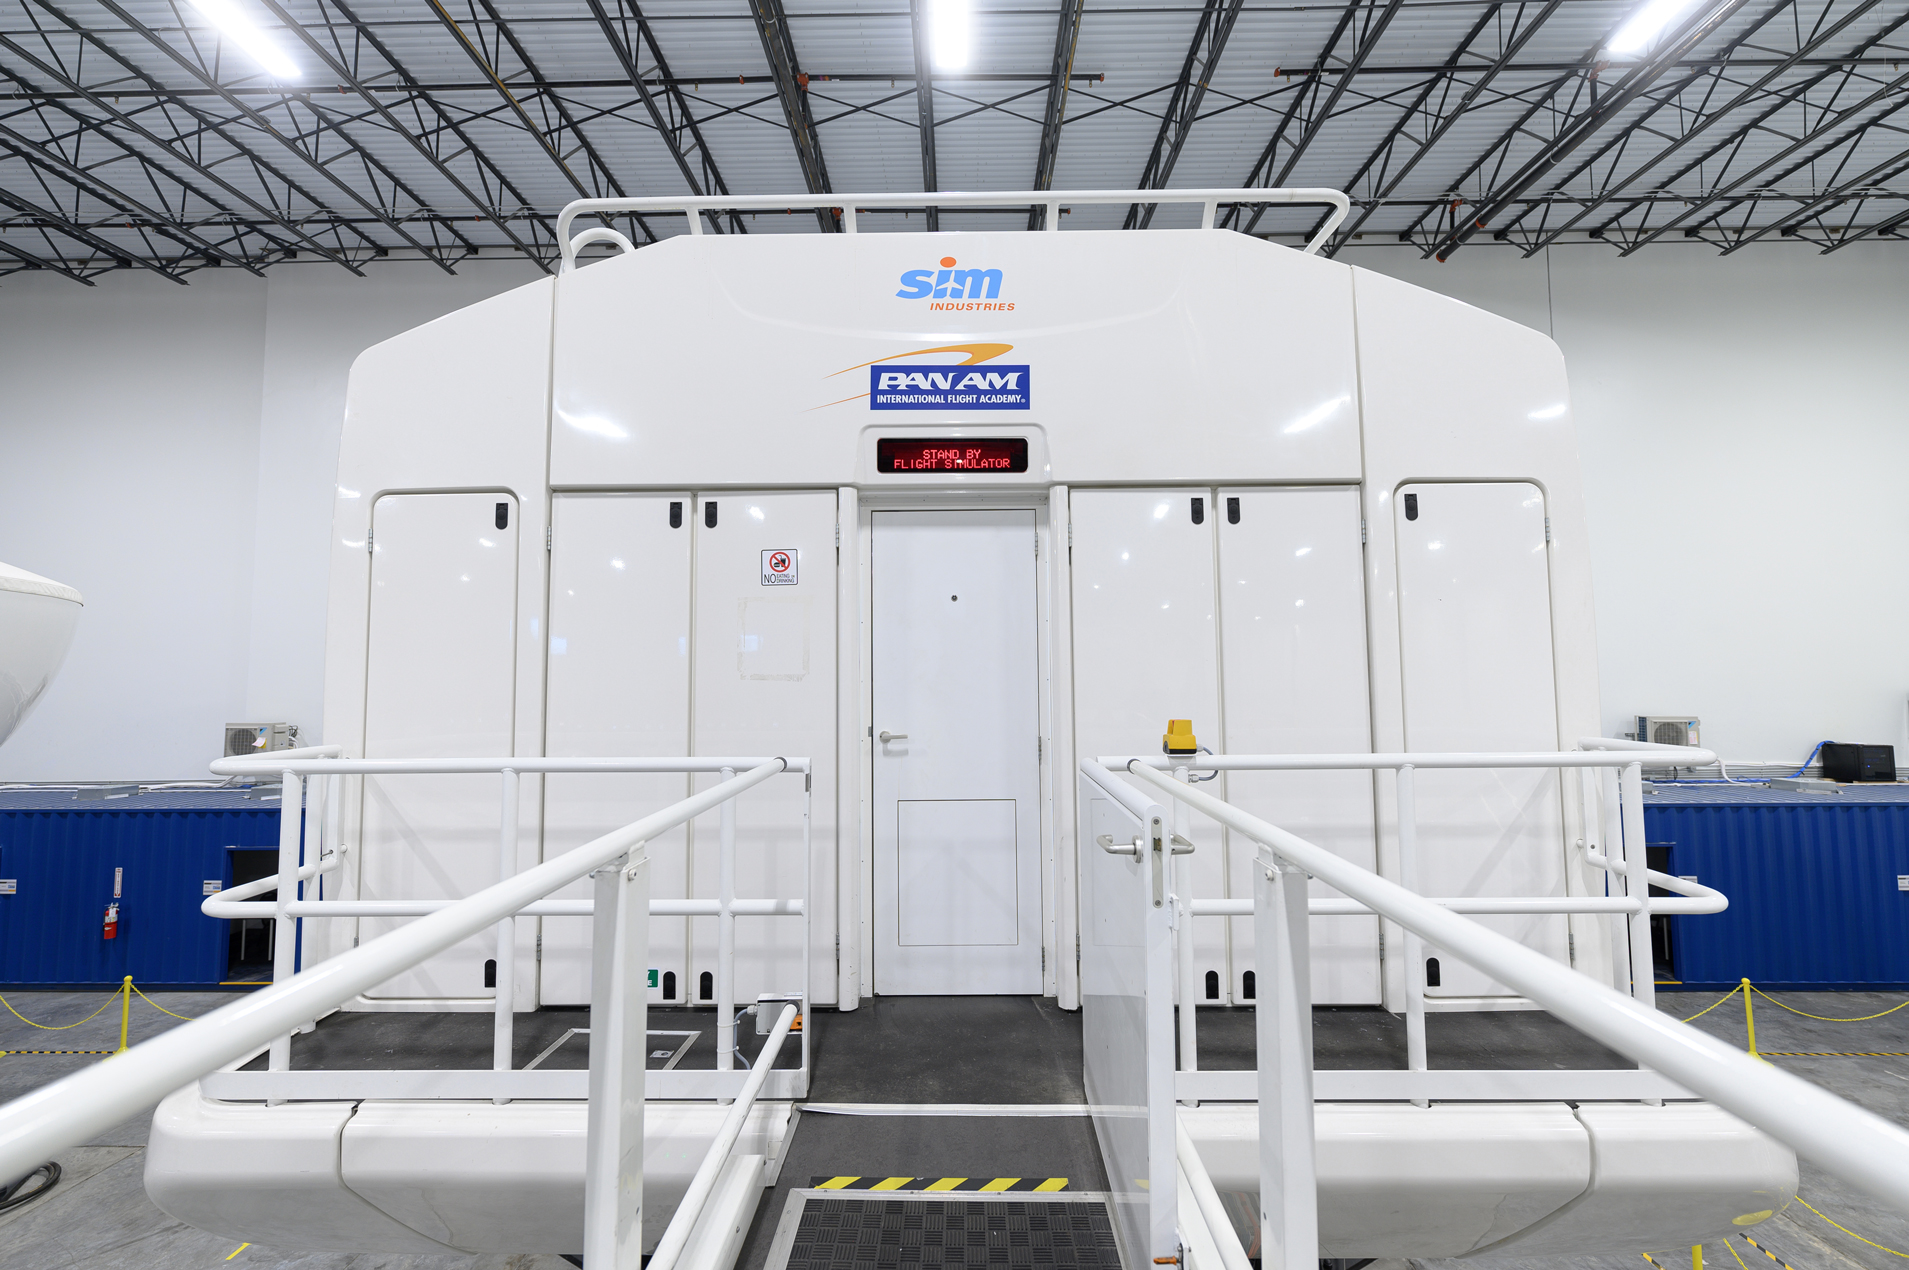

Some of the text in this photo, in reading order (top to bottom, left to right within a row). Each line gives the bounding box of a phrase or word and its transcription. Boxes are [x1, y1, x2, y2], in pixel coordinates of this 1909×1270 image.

[895, 256, 1003, 299] sim
[930, 303, 1015, 311] INDUSTRIES
[878, 373, 1024, 390] PAN AM
[877, 395, 945, 403] INTERNATIONAL
[948, 395, 977, 403] FLIGHT
[923, 449, 981, 459] STAND BY
[894, 459, 1010, 469] FLIGHT SIMULATOR
[764, 573, 776, 583] NO
